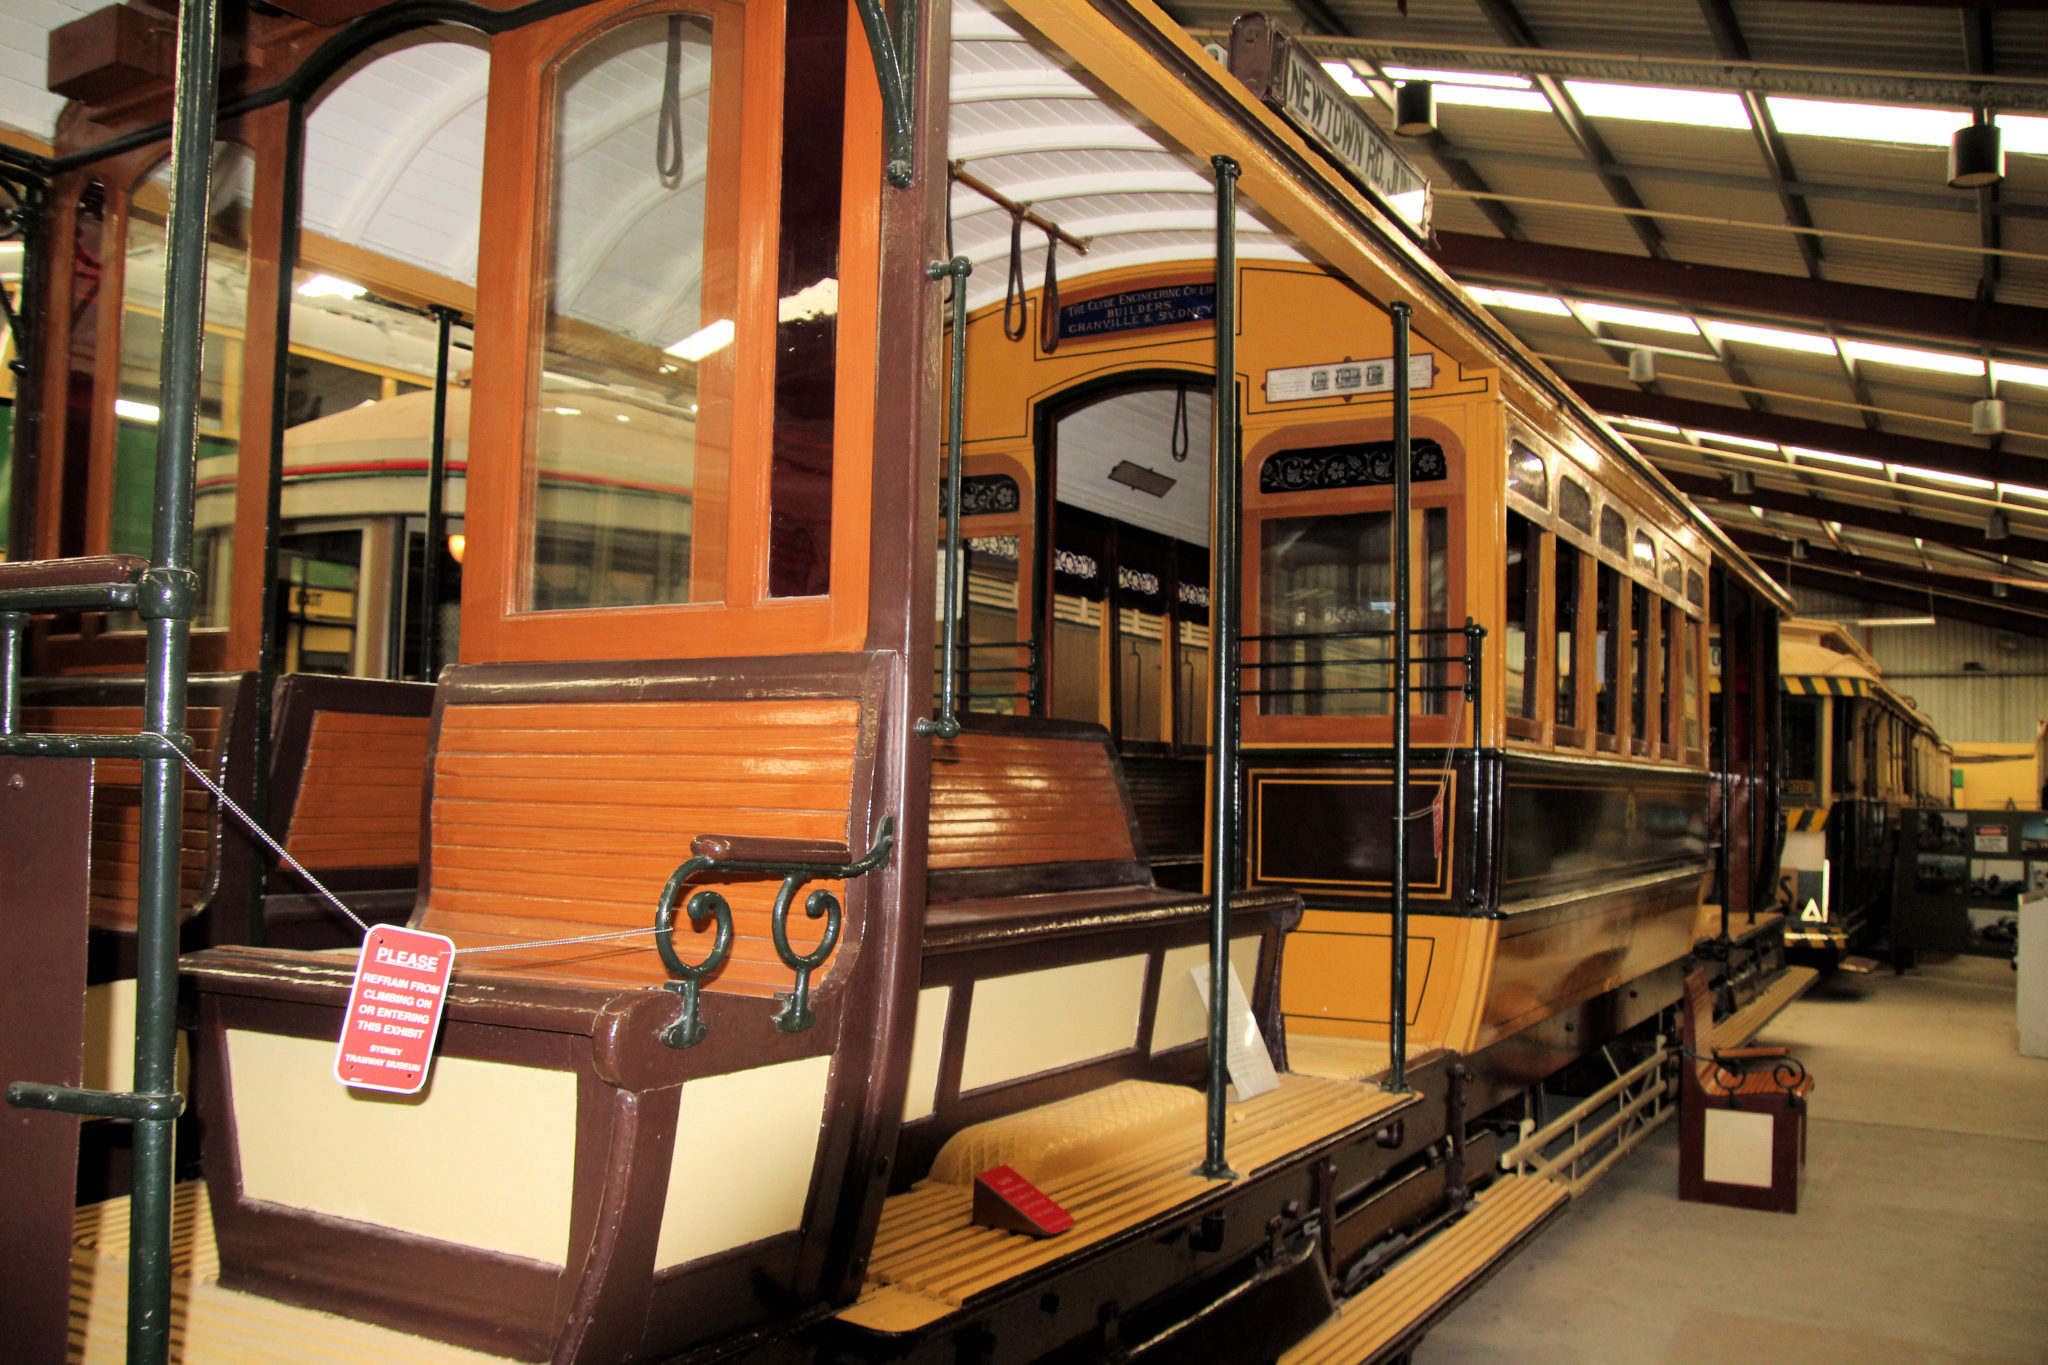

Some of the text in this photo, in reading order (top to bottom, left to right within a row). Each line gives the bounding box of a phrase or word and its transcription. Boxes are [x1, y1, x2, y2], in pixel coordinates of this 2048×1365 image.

[1289, 60, 1364, 166] NEWTOWN
[1067, 304, 1085, 318] THE
[1087, 297, 1115, 312] CLYDE
[1119, 288, 1180, 304] ENGINEERING
[1107, 301, 1171, 318] BUILDERS
[1068, 304, 1214, 334] GRANVILLE & SYDNEY
[376, 947, 438, 971] PLEASE
[362, 972, 440, 995] REFRAIN FROM
[364, 990, 431, 1009] CLIMBING ON
[359, 1004, 429, 1024] OR ENTERING
[358, 1020, 424, 1039] THIS EXHIBIT
[370, 1045, 402, 1056] SYDNEY
[345, 1054, 421, 1072] TRAMWAY MUSEUM
